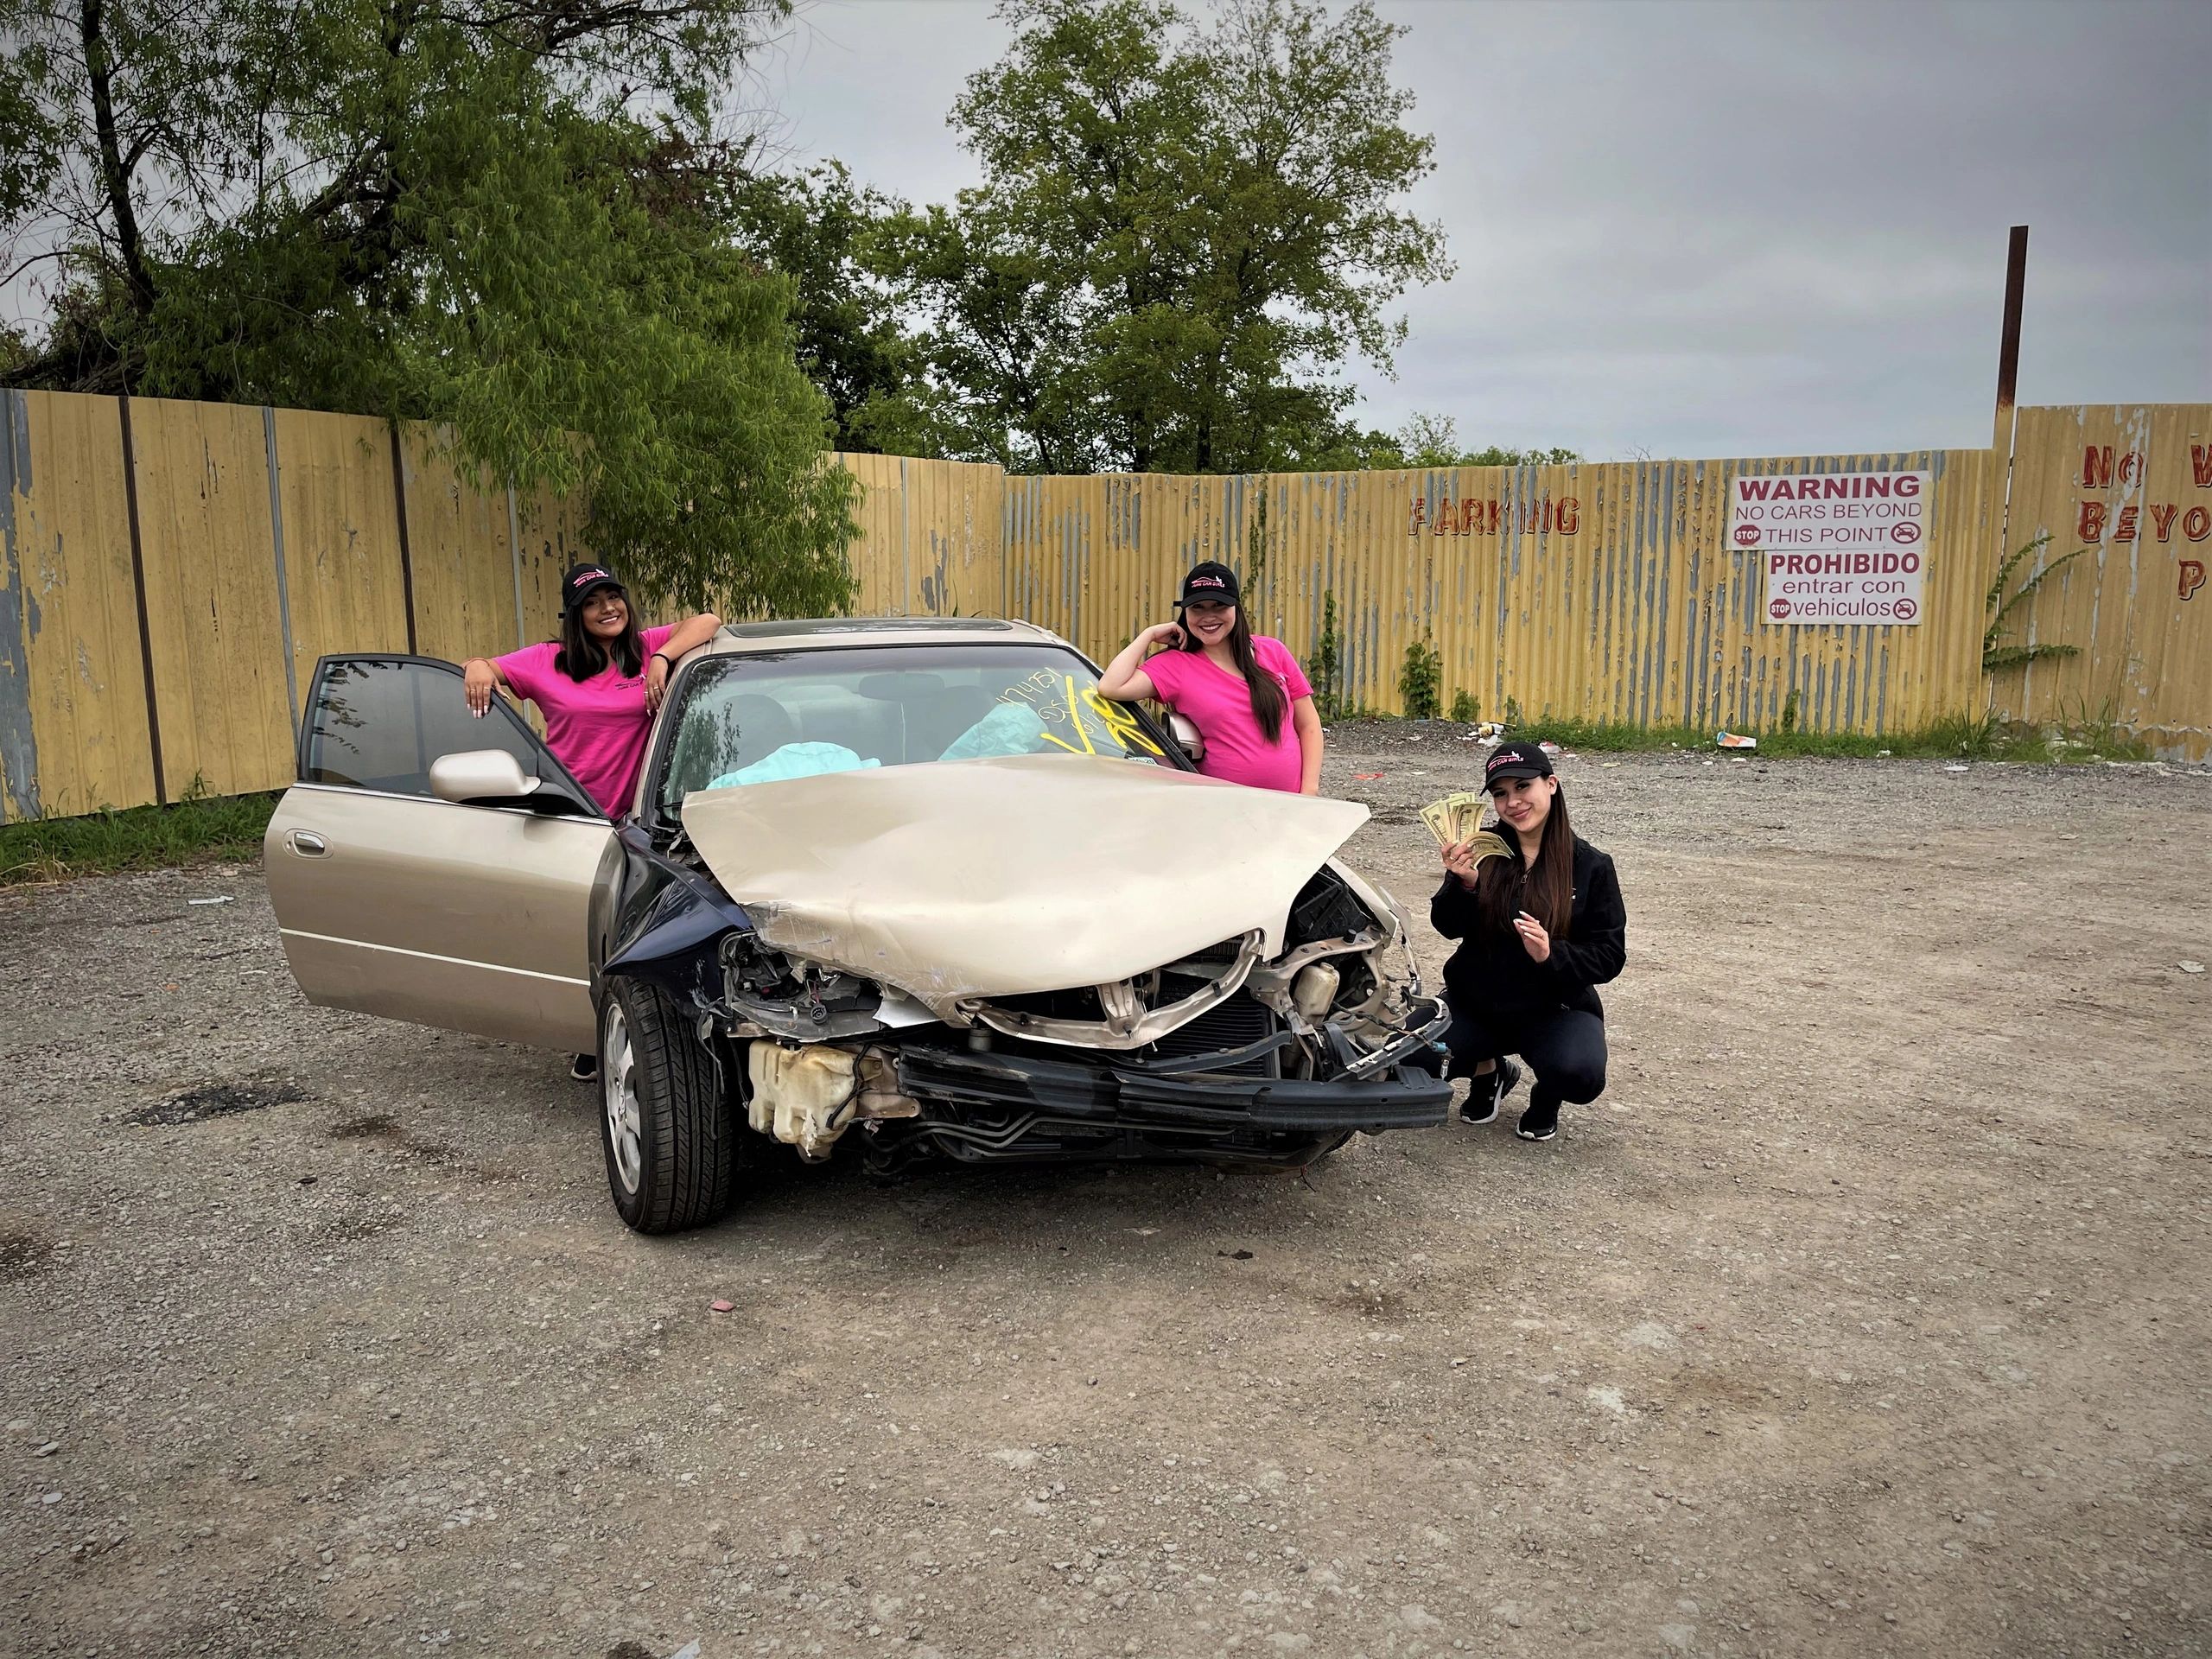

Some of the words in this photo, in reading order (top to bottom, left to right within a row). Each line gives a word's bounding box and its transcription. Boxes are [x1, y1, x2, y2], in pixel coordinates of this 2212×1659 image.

[1739, 475, 1920, 501] WARNING
[1736, 506, 1764, 520] NO
[1771, 505, 1826, 519] CARS
[1834, 503, 1922, 518] BEYOND
[1735, 531, 1760, 540] STOP
[1765, 528, 1813, 543] THIS
[1821, 526, 1888, 543] POINT
[1770, 552, 1920, 575] PROHIBIDO
[1783, 578, 1853, 594] entrar
[1861, 581, 1905, 594] con
[1770, 604, 1791, 614] STOP
[1794, 598, 1891, 617] vehiculos
